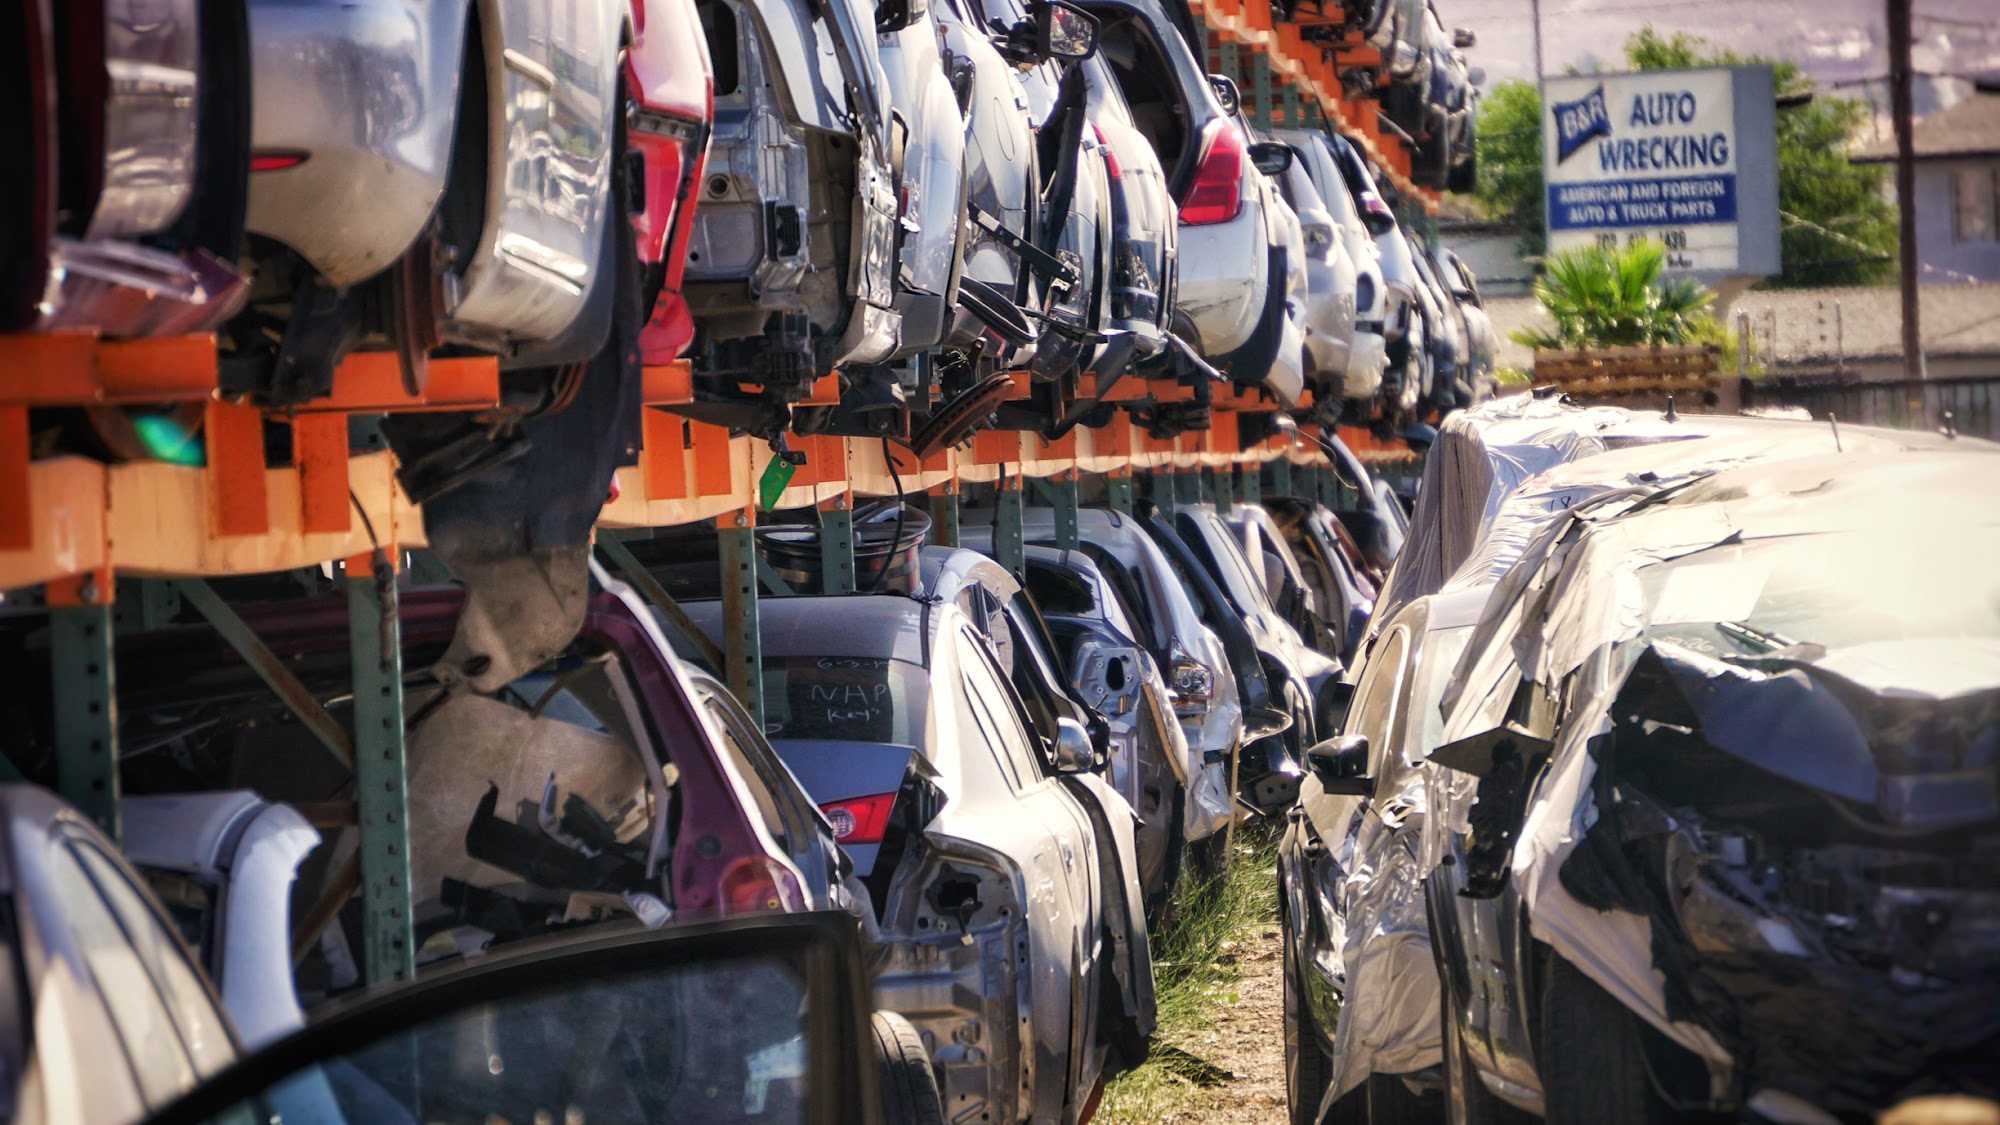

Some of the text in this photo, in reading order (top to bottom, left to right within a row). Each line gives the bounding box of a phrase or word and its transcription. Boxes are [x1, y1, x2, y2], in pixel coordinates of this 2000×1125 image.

[1561, 94, 1605, 140] B&R
[1630, 90, 1696, 127] AUTO
[1598, 132, 1728, 171] WRECKING
[1560, 179, 1725, 204] AMERICAN AND FOREIGN
[1568, 200, 1716, 223] AUTO & TRUCK PARTS
[811, 683, 886, 705] NHP
